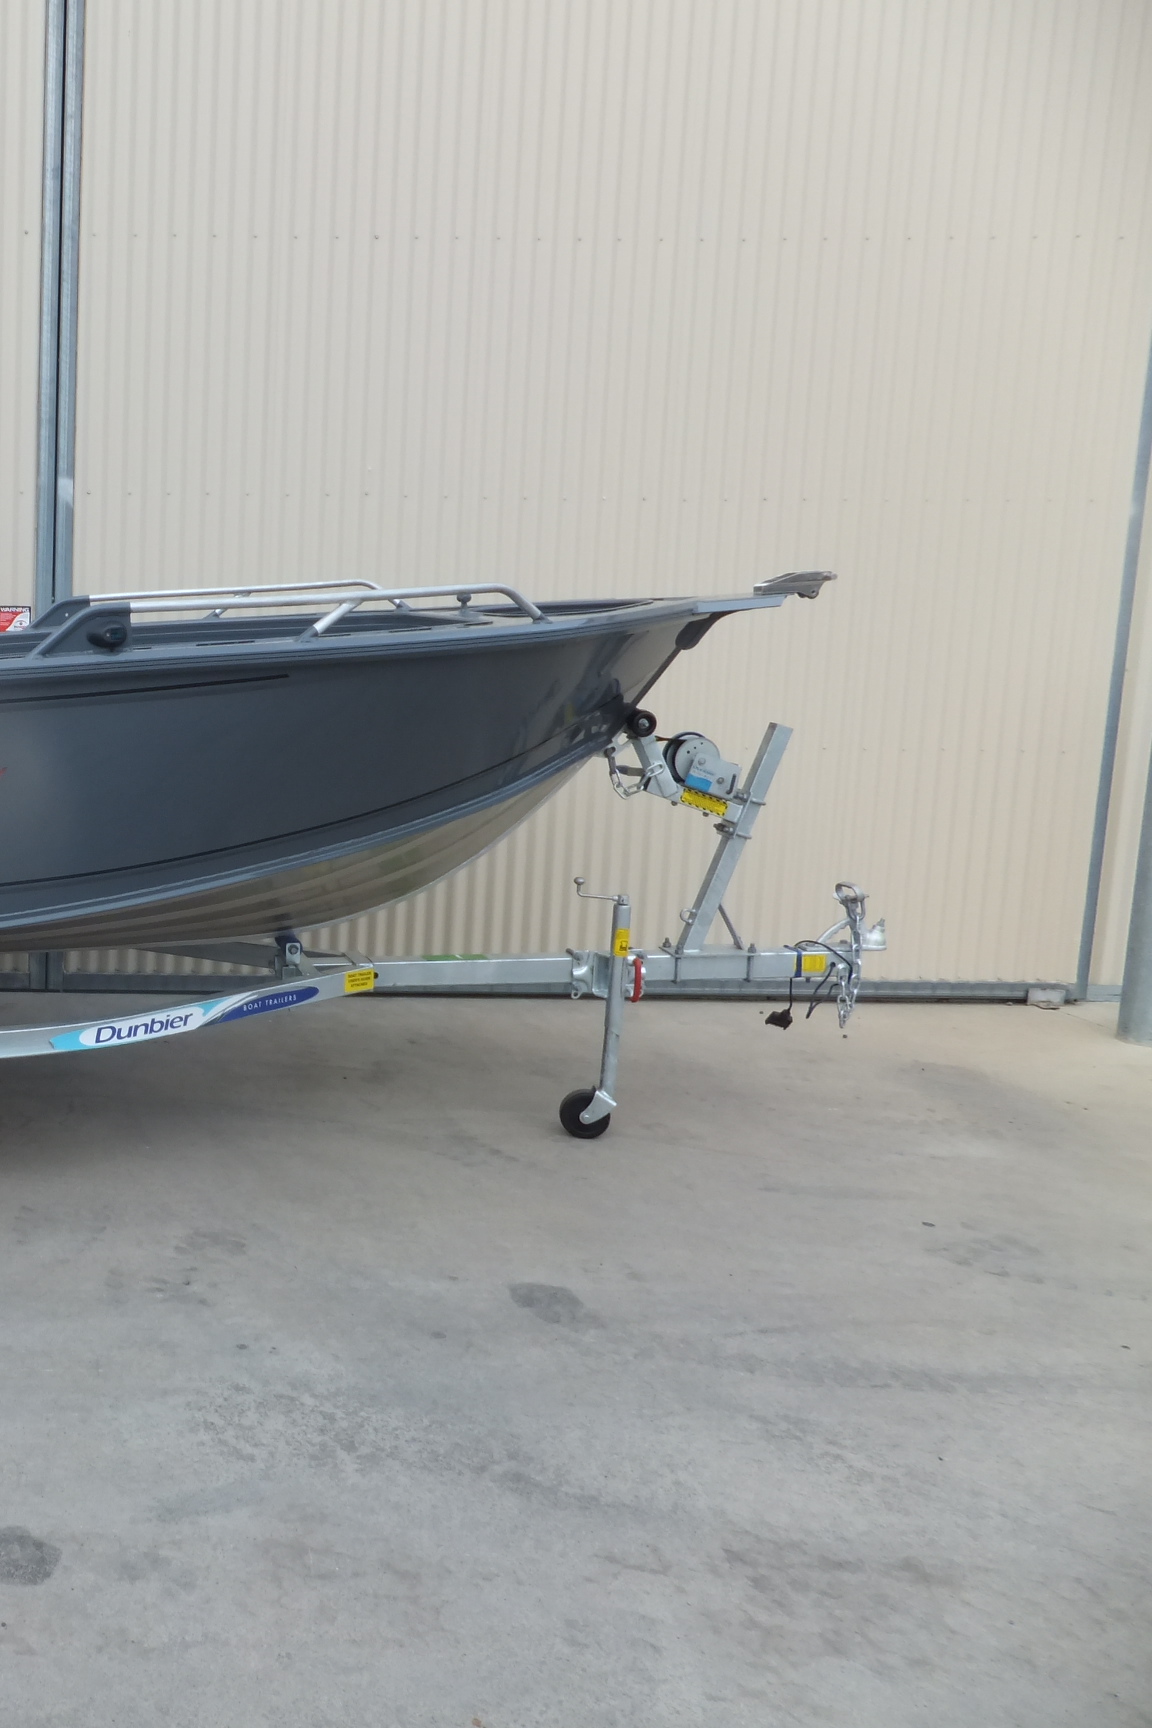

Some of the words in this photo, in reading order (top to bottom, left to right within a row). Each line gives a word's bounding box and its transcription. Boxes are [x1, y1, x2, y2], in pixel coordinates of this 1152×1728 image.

[243, 1001, 262, 1012] BOAT
[265, 994, 297, 1006] TRAILERS
[94, 1012, 193, 1044] Dunbier
